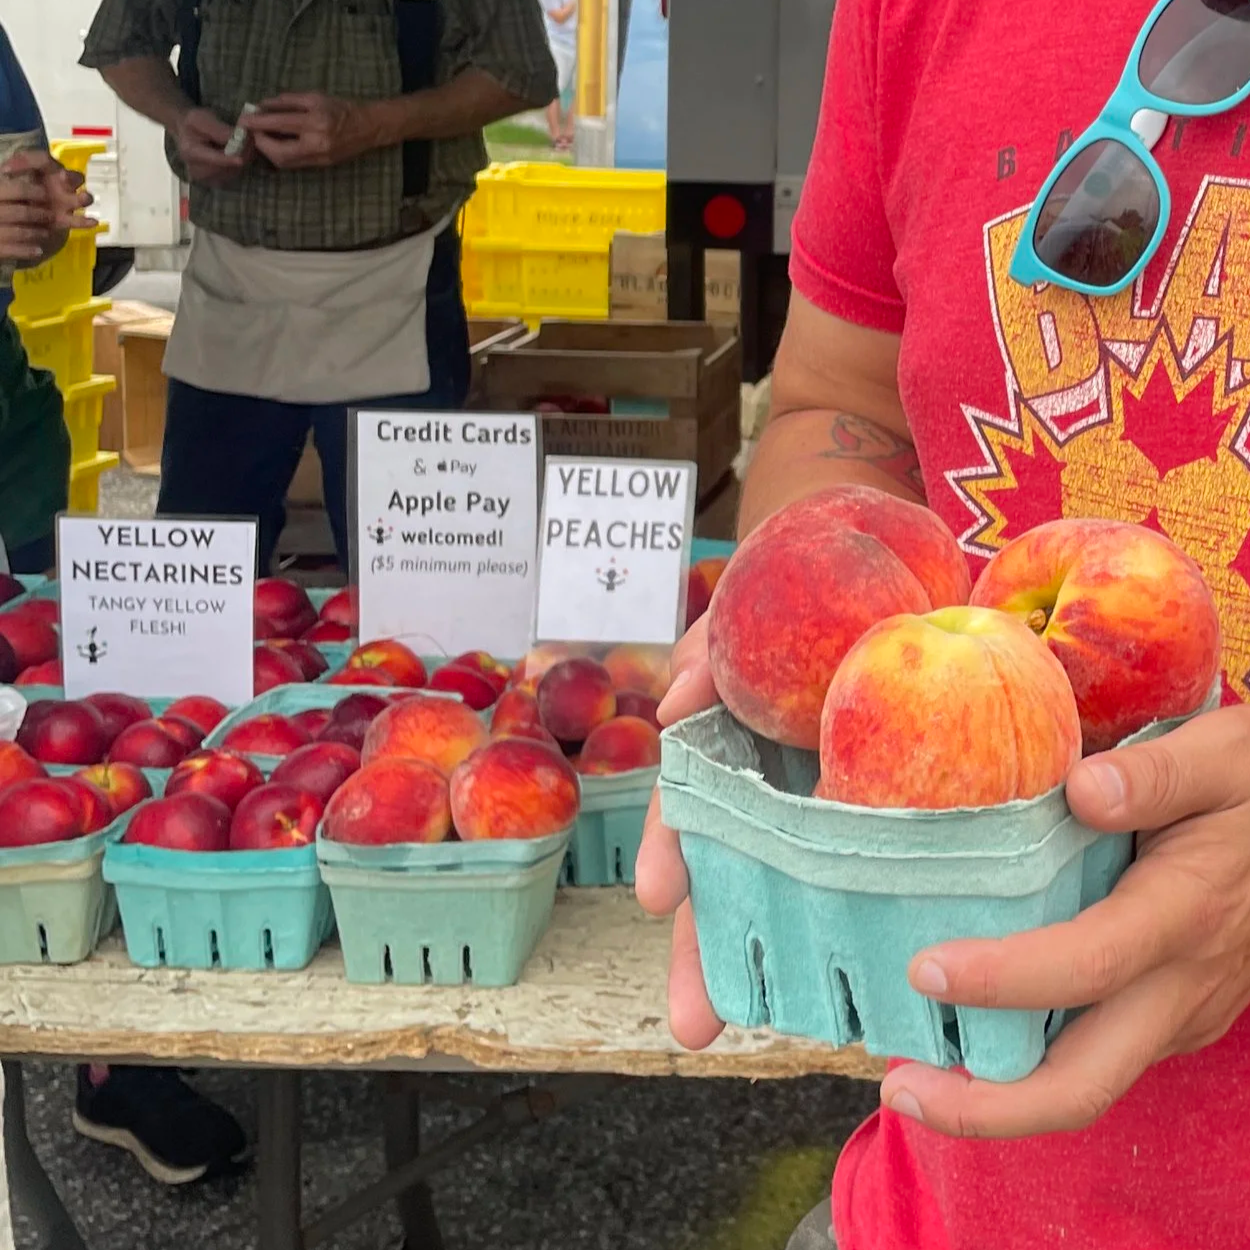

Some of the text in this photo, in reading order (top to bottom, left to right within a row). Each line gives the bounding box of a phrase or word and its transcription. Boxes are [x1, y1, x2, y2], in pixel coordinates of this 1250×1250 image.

[377, 420, 533, 445] Credit Cards
[413, 458, 478, 476] & Pay
[559, 467, 682, 499] YELLOW
[388, 490, 511, 518] Apple Pay
[98, 525, 215, 549] YELLOW
[401, 527, 503, 548] welcomed!
[546, 518, 685, 551] PEACHES
[72, 560, 243, 586] NECTARINES
[371, 556, 529, 578] ($5 minimum please)
[88, 596, 226, 614] TANGY YELLOW
